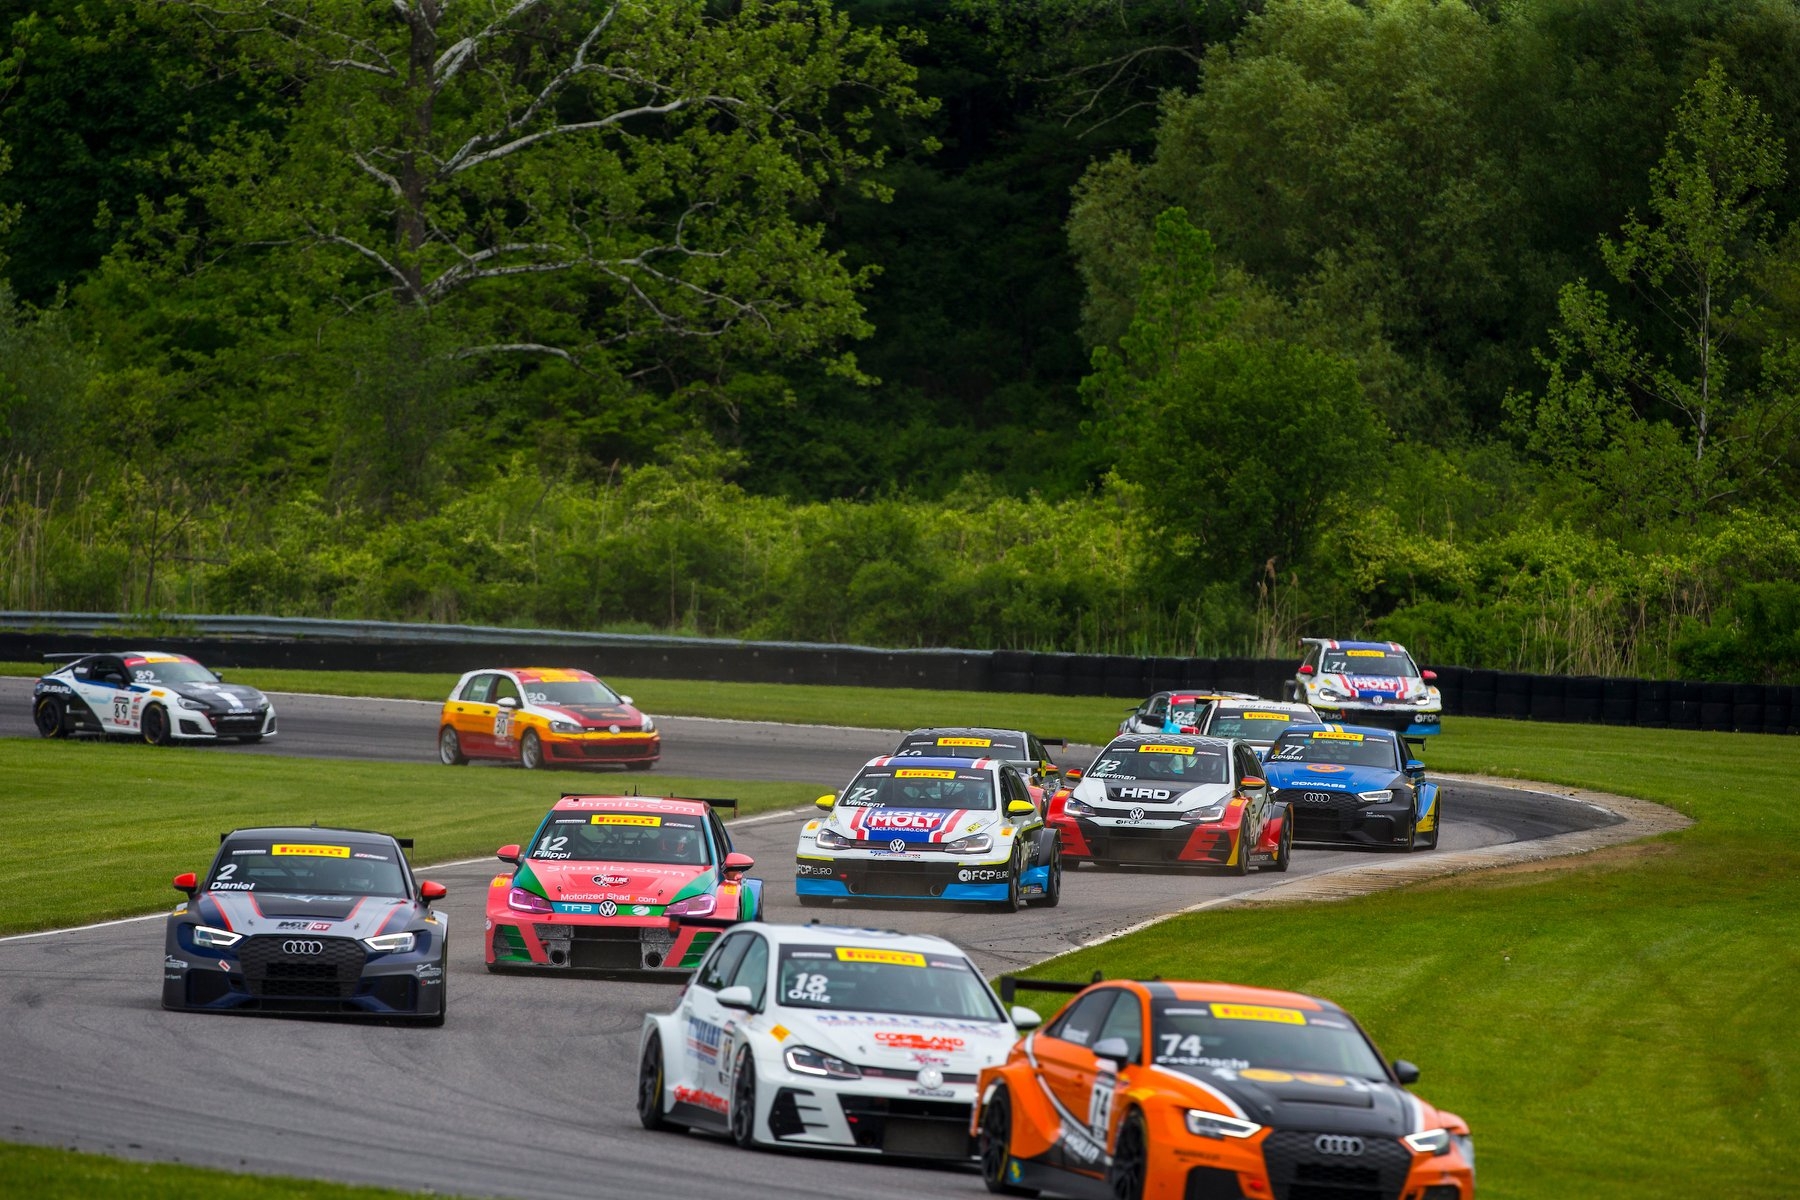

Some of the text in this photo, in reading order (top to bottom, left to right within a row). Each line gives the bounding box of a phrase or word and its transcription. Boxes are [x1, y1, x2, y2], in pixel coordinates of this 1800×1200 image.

[1331, 661, 1347, 670] 71
[136, 670, 154, 680] 89
[43, 685, 71, 694] SUBARU
[1354, 681, 1398, 690] MOLY
[114, 704, 128, 718] 89
[1280, 744, 1305, 755] 77
[1096, 759, 1121, 771] 73
[1090, 772, 1136, 781] Merriman
[1291, 781, 1346, 789] COMPASS
[849, 787, 878, 801] 72
[1120, 787, 1171, 801] HRD
[845, 798, 886, 809] Vincent
[598, 816, 655, 825] PIRELLI
[870, 816, 937, 828] MOLY
[540, 835, 569, 851] 12
[533, 850, 572, 860] Filippi
[216, 863, 238, 881] 2
[812, 866, 833, 876] EURO
[971, 868, 996, 881] FCP
[210, 881, 256, 891] Daniel
[560, 893, 604, 901] Motorized
[561, 903, 592, 912] TFB
[846, 950, 916, 963] PIRELLI
[792, 972, 828, 994] 18
[787, 989, 832, 1004] Ortiz
[1159, 1034, 1203, 1057] 74
